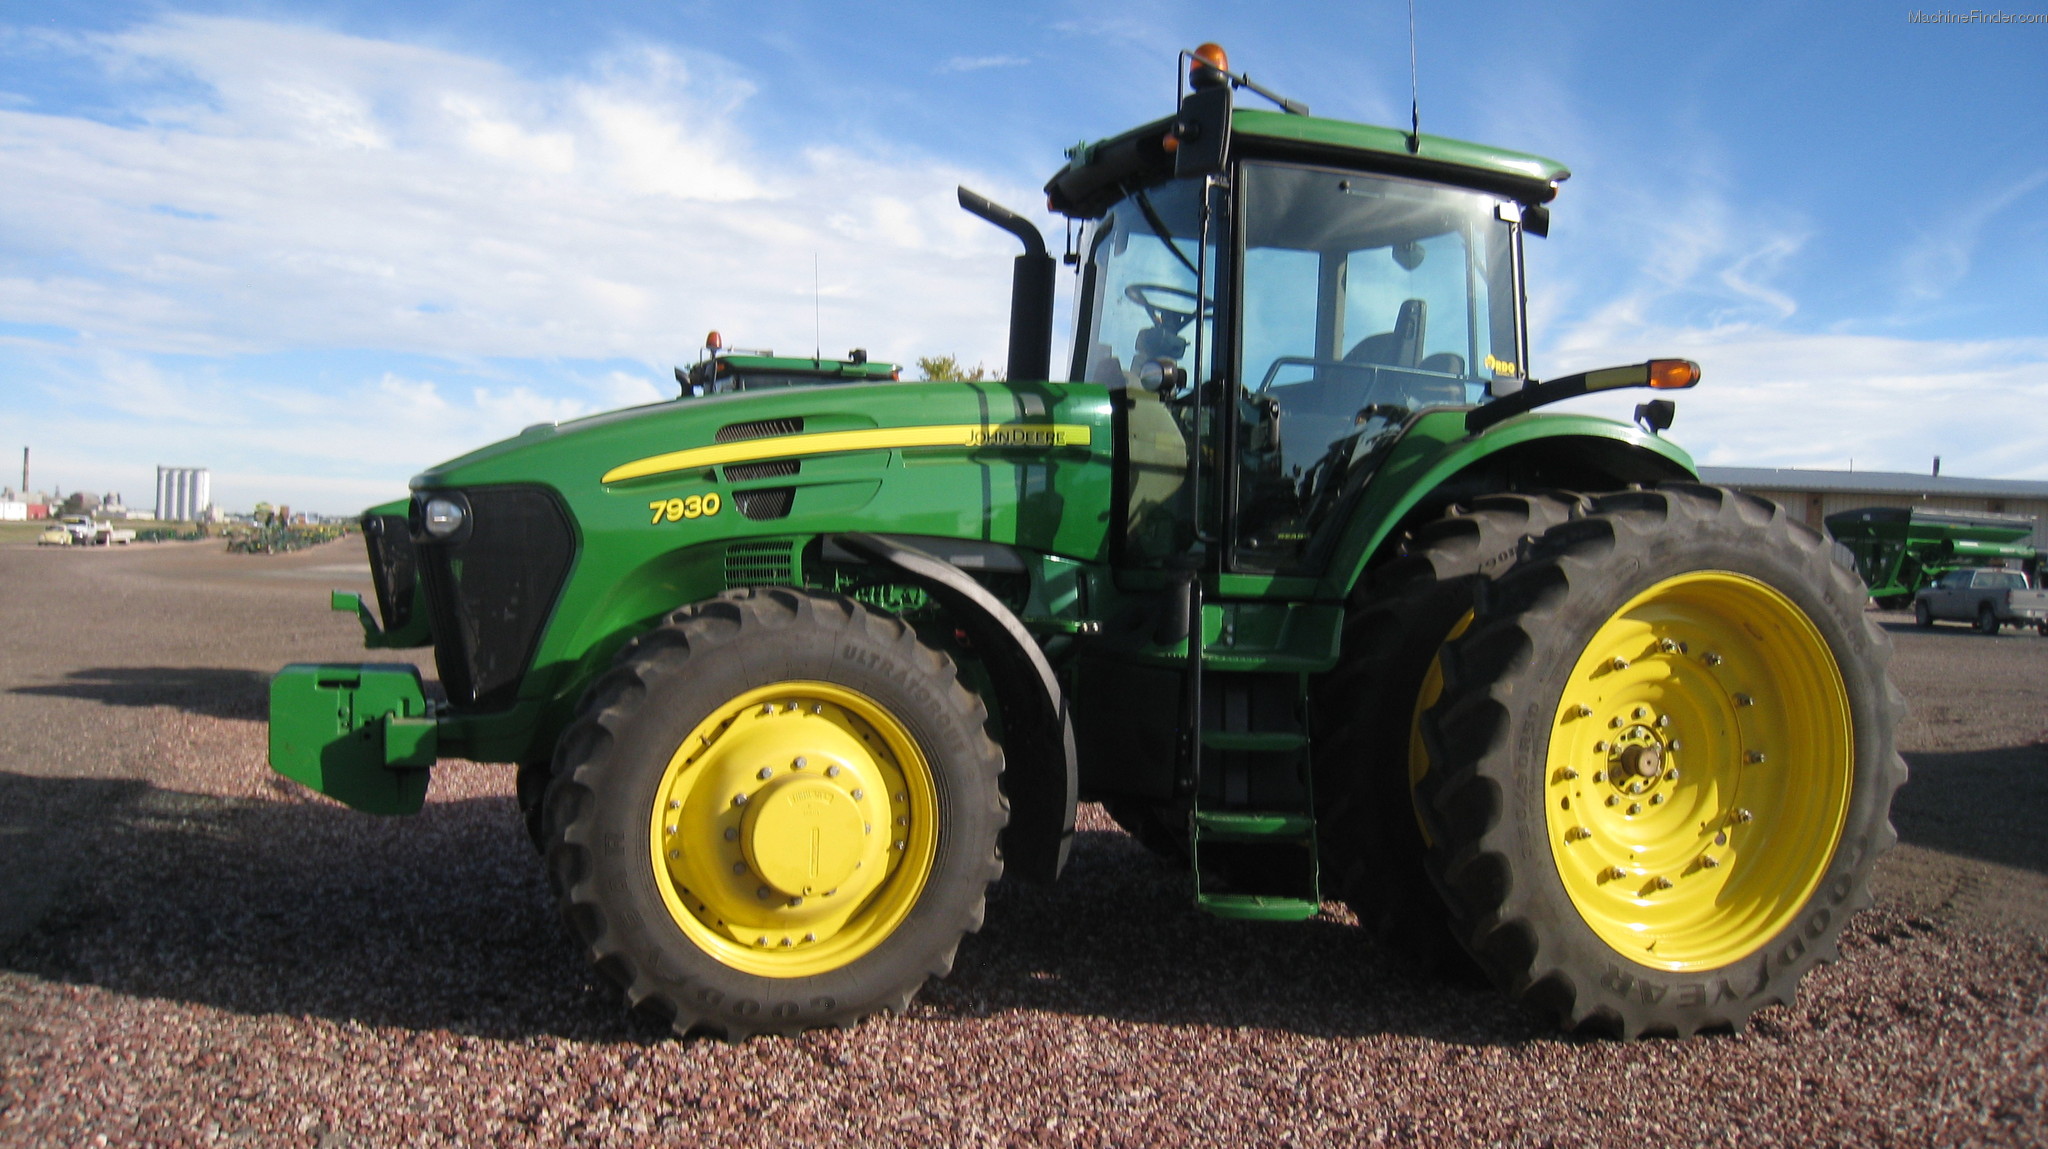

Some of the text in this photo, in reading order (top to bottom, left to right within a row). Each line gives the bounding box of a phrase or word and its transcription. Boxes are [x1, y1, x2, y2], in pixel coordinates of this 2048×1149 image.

[965, 428, 1066, 446] JOHN DEERE
[649, 492, 722, 525] 7930
[1600, 836, 1869, 1010] GOODYEAR
